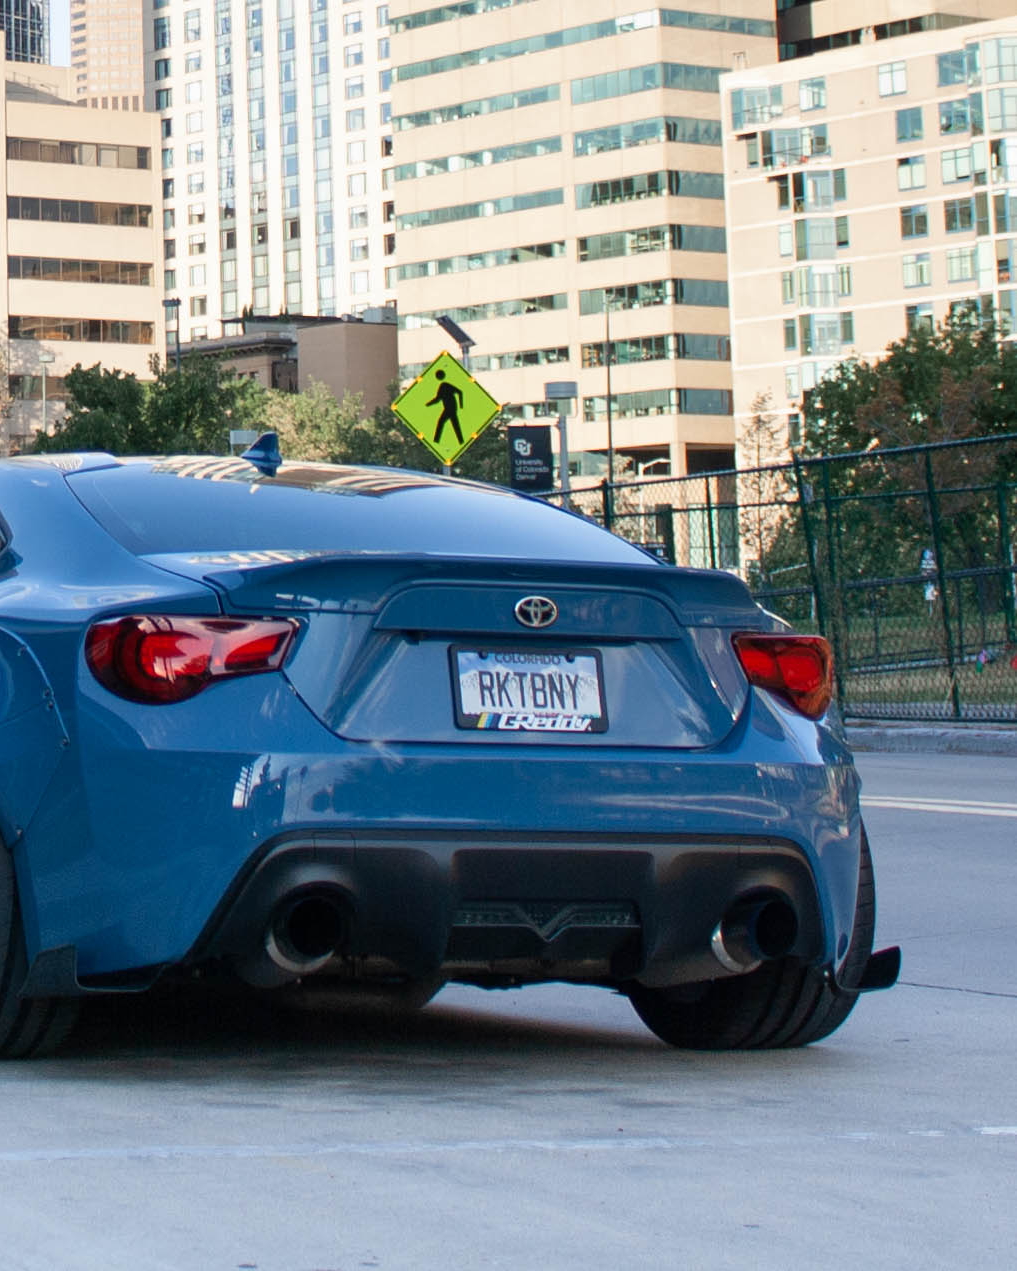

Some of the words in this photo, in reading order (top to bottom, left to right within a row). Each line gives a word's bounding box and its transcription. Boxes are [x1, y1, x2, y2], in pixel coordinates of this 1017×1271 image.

[513, 438, 532, 456] CU
[494, 653, 561, 665] COLORADO
[478, 670, 580, 710] RKTBNY
